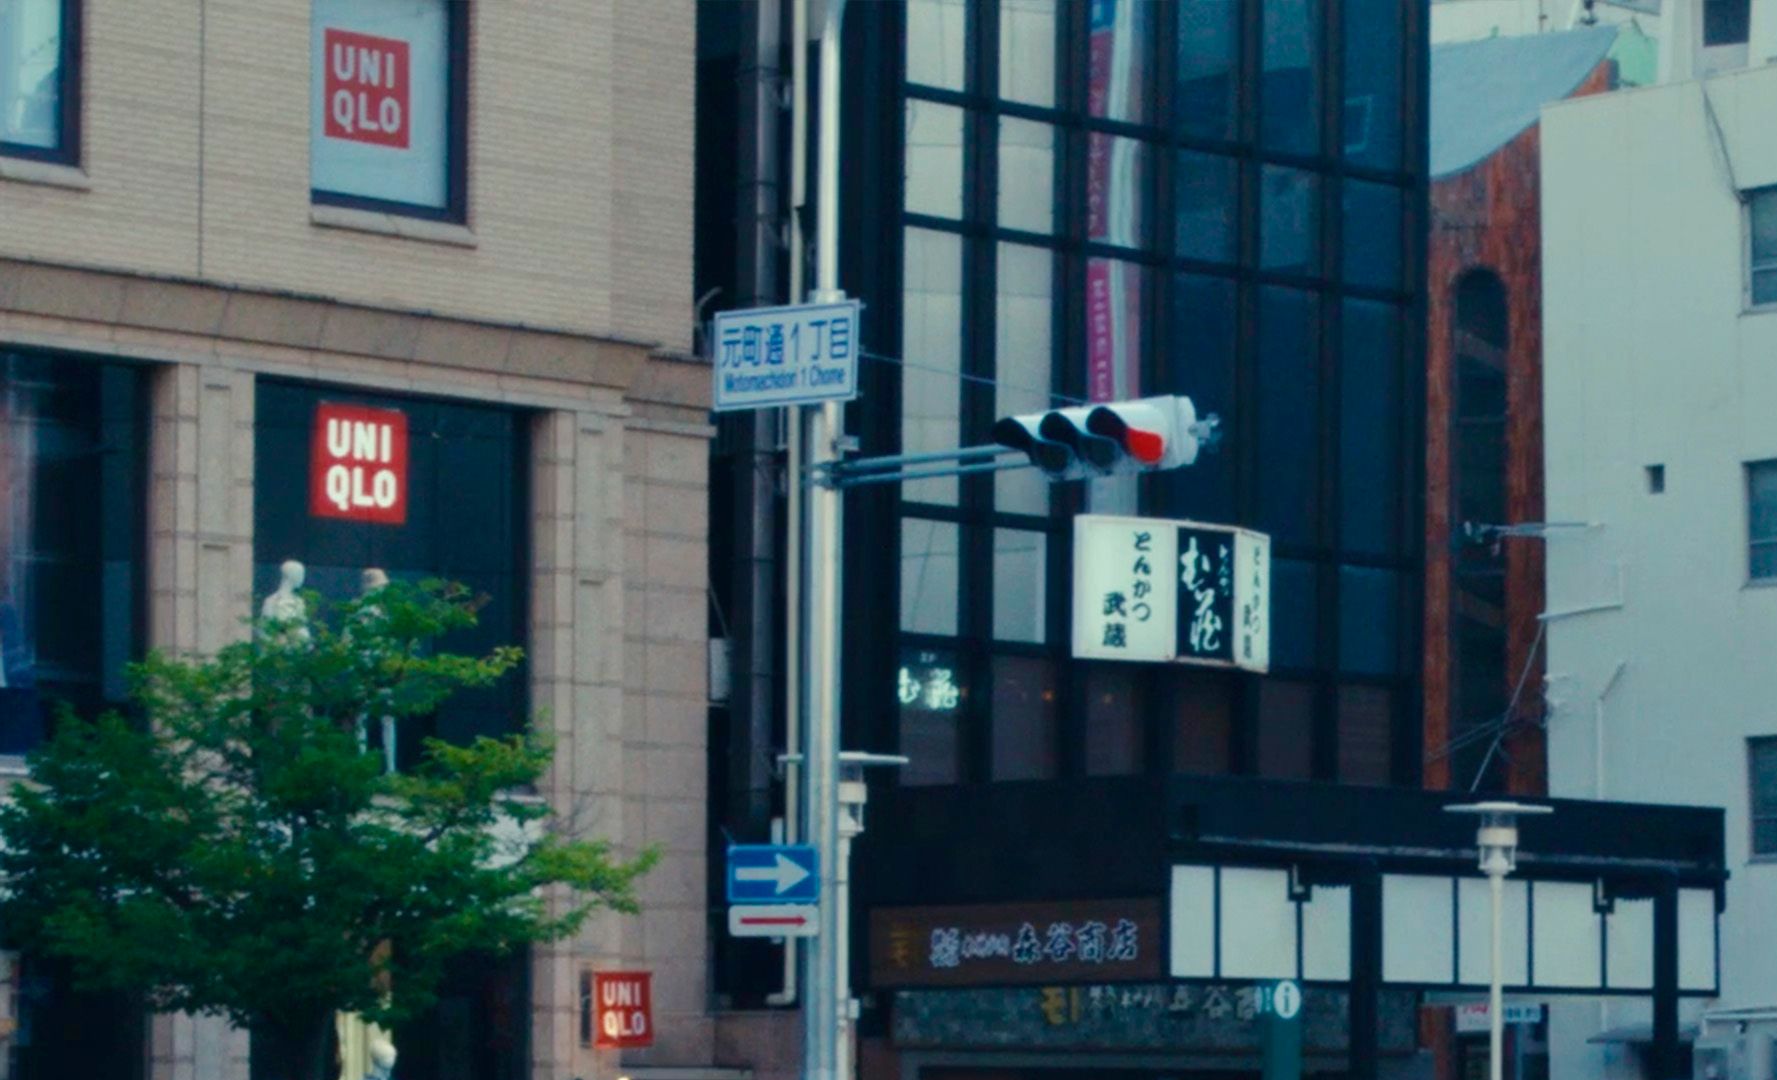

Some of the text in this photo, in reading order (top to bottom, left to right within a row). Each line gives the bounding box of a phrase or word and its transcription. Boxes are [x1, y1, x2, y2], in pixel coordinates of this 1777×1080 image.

[333, 43, 396, 83] UNI
[333, 95, 401, 135] QLO
[328, 420, 392, 463] UNI
[326, 468, 397, 511] QLO
[1132, 531, 1152, 622] とんかつ
[1102, 591, 1127, 648] 武蔵
[603, 980, 641, 1007] UNI
[603, 1010, 645, 1039] QLO
